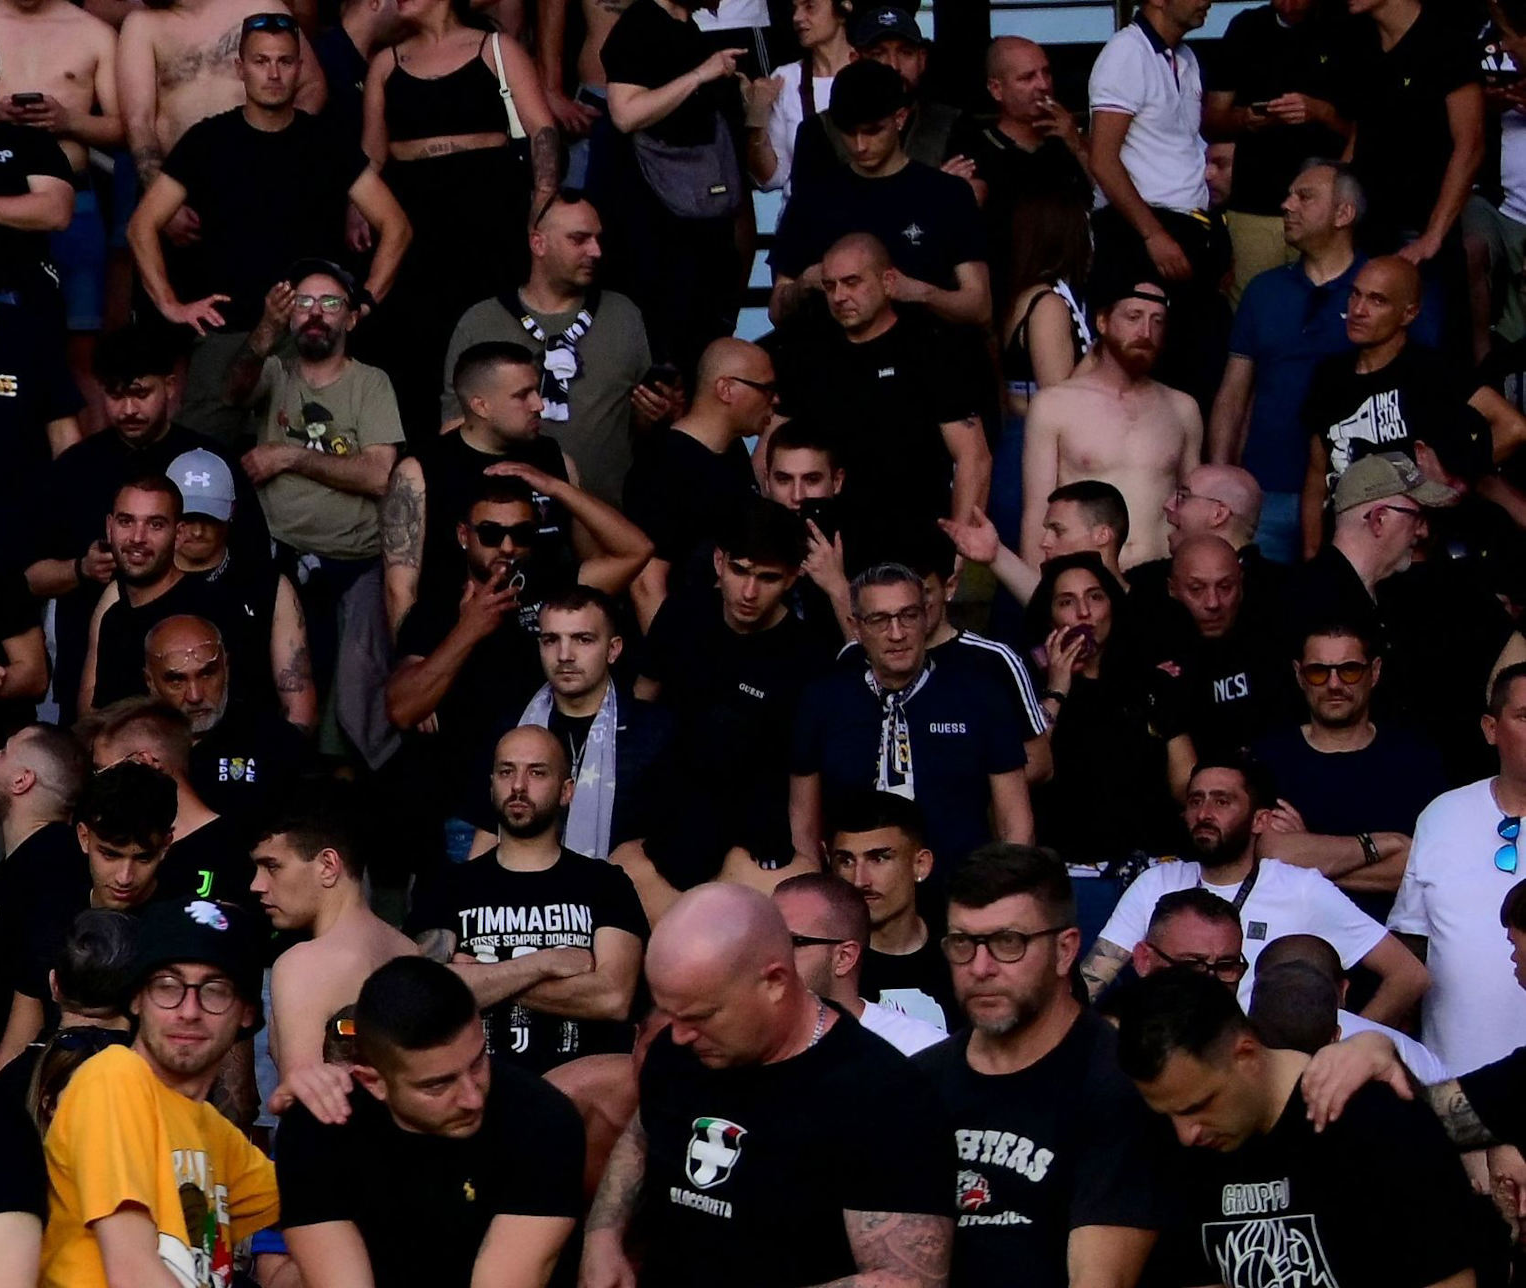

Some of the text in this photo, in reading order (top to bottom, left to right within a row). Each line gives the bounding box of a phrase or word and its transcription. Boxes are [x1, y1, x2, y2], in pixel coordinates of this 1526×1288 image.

[1376, 388, 1397, 410] INCI
[1380, 420, 1408, 444] MOLI
[1213, 672, 1248, 704] NCS
[929, 722, 967, 734] GUESS
[502, 934, 542, 948] SEMPRE
